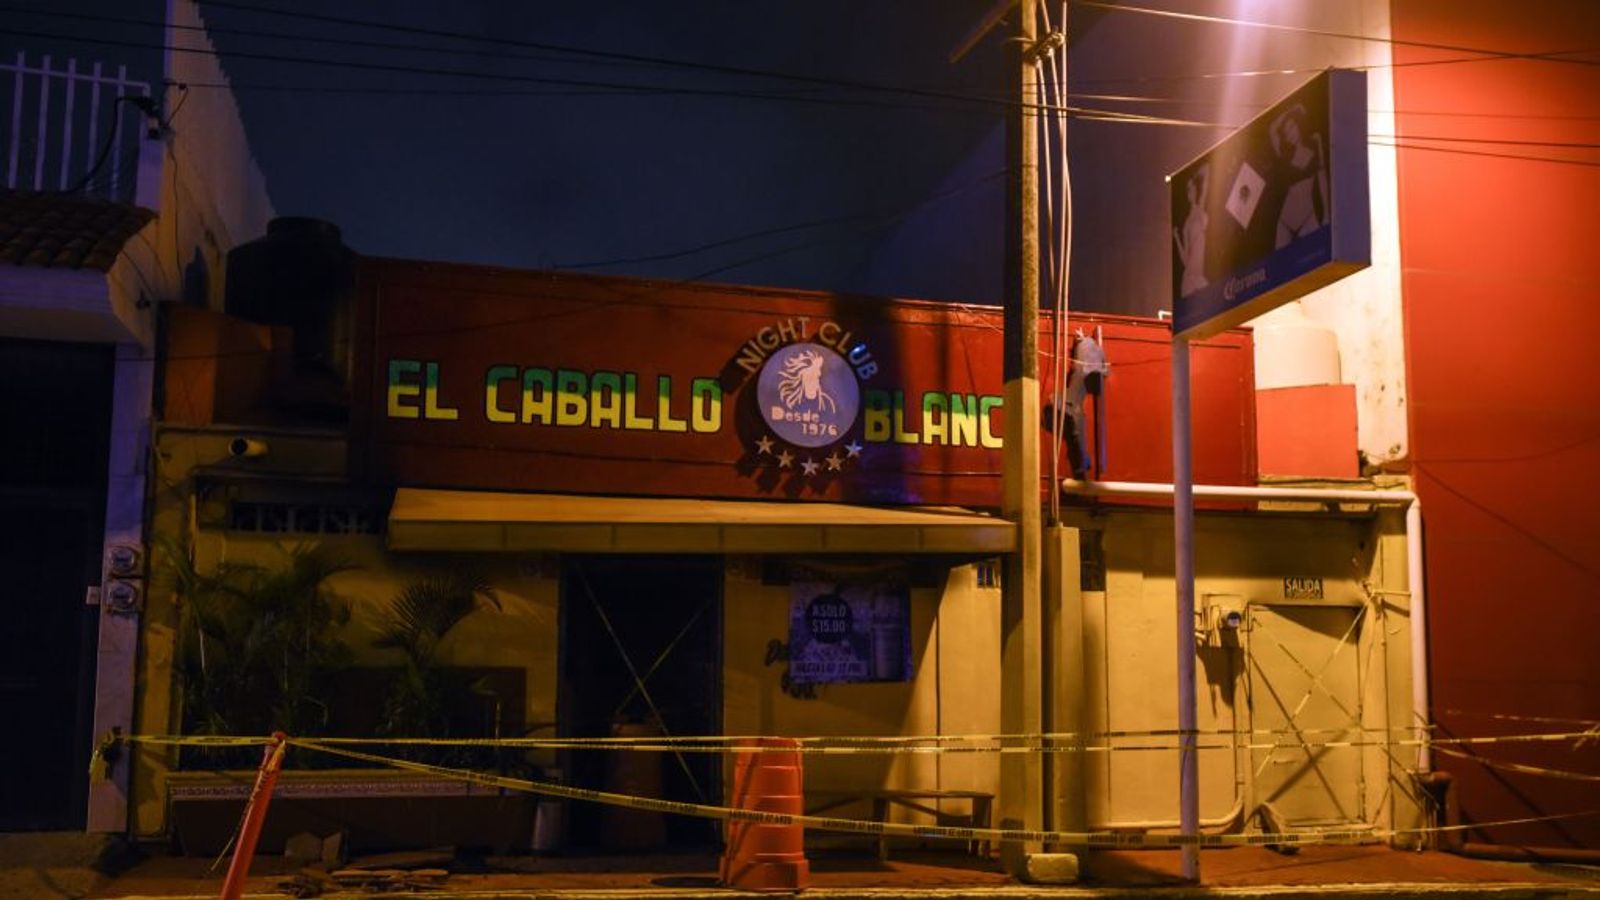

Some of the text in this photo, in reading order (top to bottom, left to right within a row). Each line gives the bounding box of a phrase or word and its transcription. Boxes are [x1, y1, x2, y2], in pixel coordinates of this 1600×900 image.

[735, 316, 879, 381] NIGHT CLUB
[387, 360, 1004, 449] EL CABALLO BLANC
[771, 406, 820, 423] Desde
[802, 423, 838, 437] 1976
[1285, 577, 1321, 593] SALIDA
